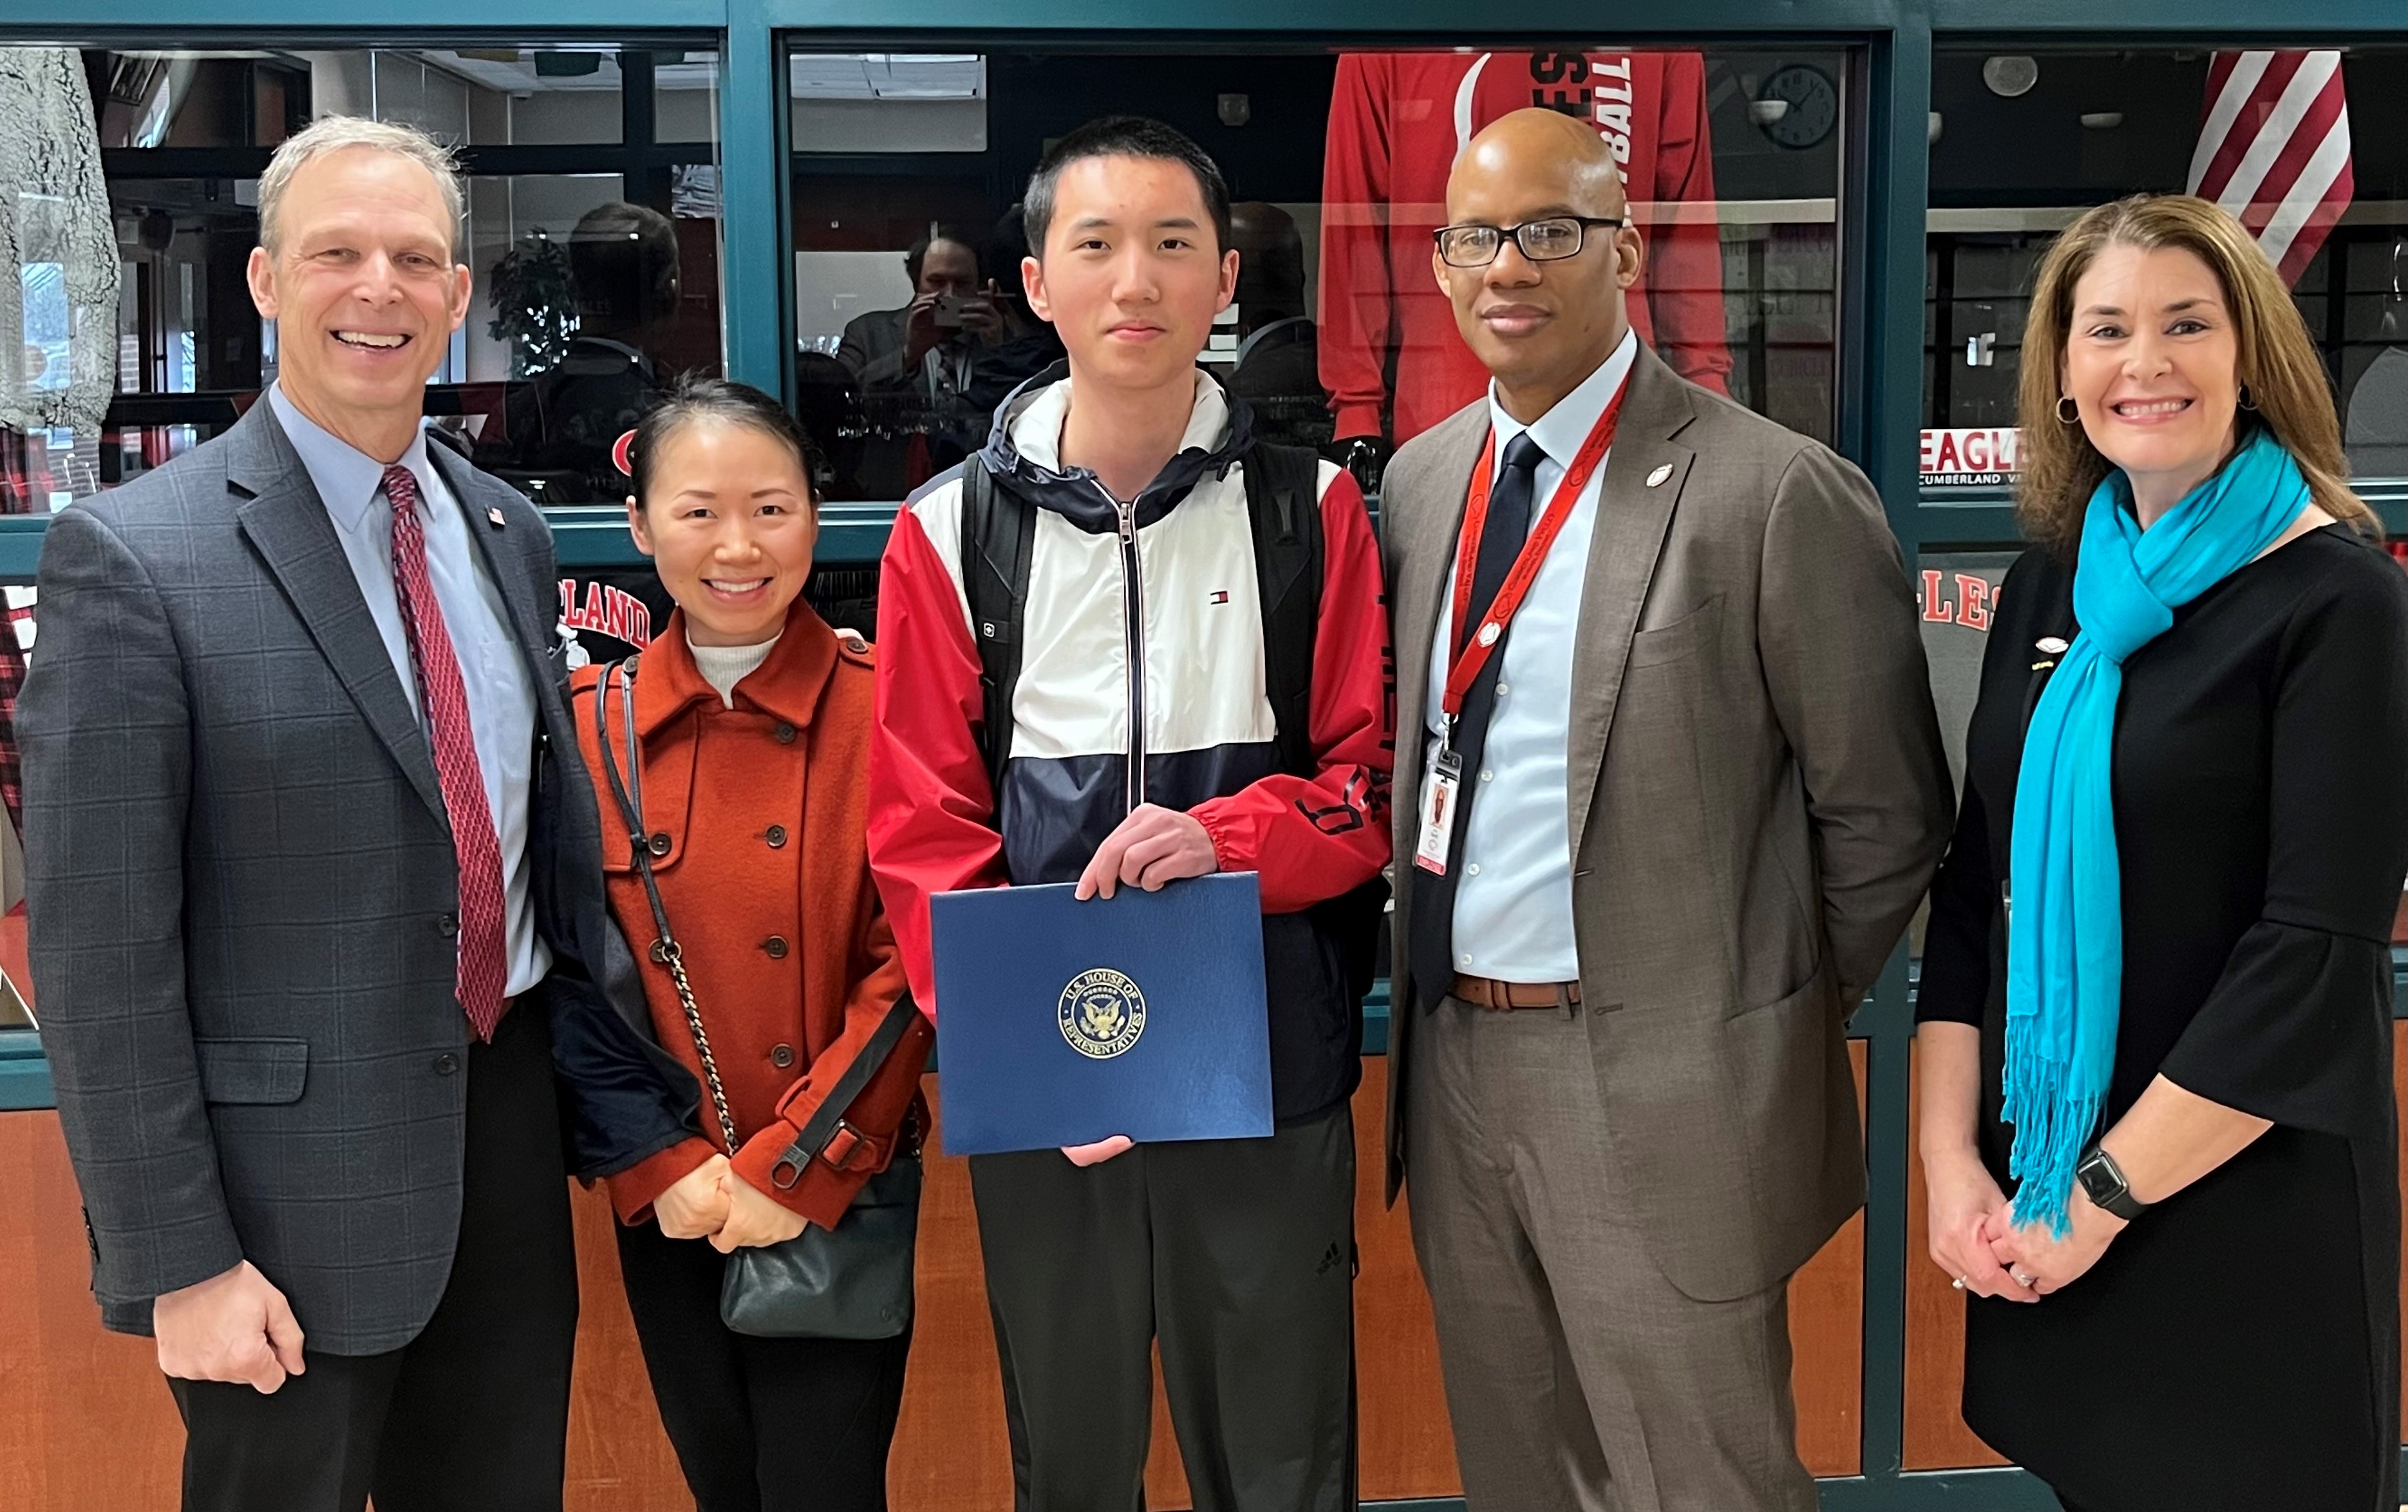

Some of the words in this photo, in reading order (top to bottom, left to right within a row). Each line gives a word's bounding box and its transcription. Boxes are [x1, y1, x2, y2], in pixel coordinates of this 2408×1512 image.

[1916, 569, 2001, 631] LE
[1084, 972, 1125, 987] HOUSE
[1123, 984, 1138, 999] OF
[1062, 1012, 1142, 1054] REPRESENTATIVES
